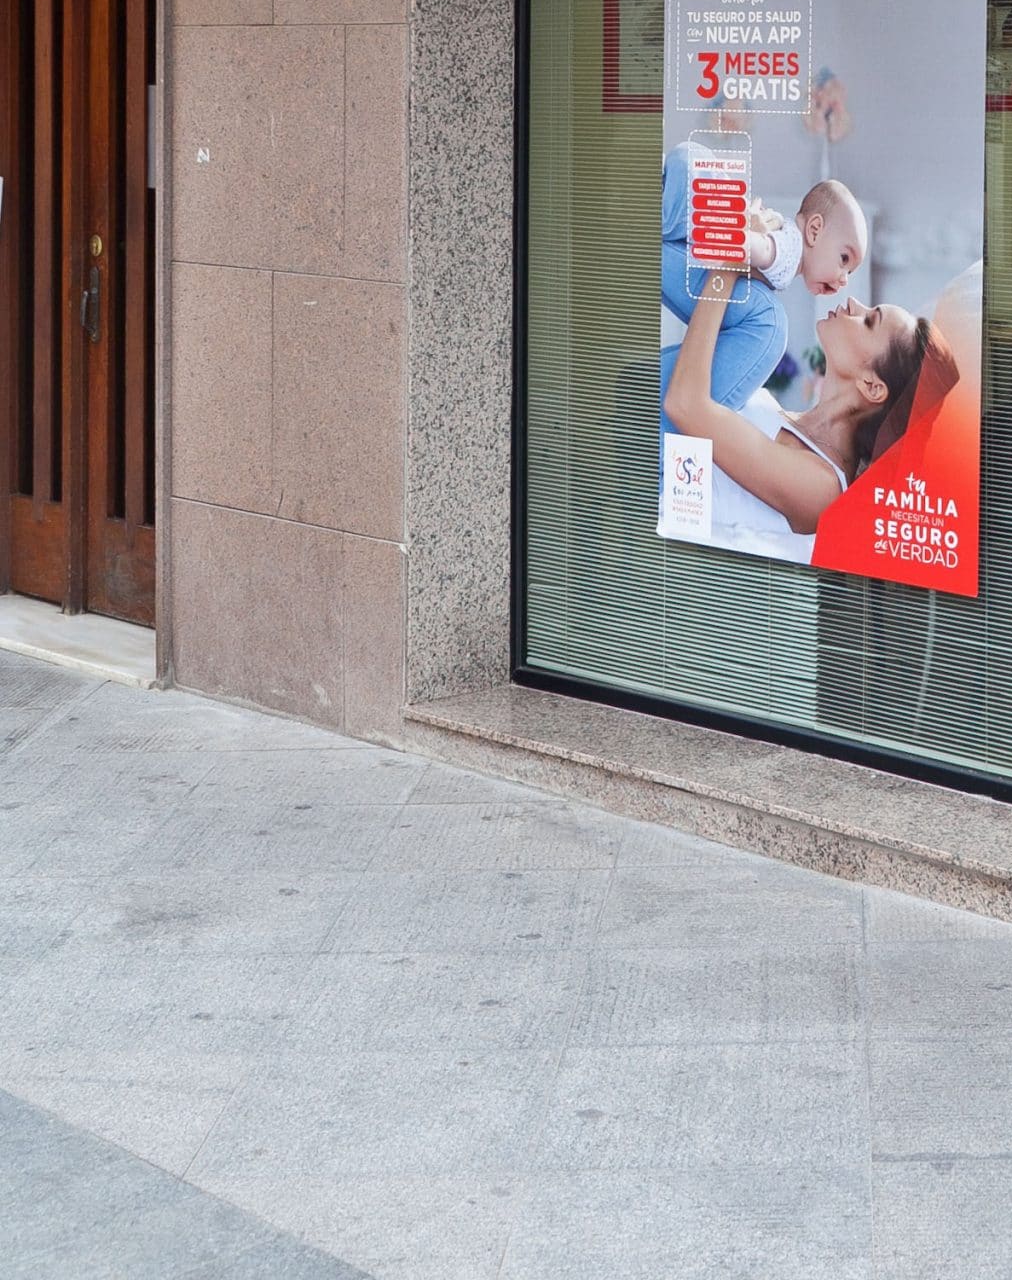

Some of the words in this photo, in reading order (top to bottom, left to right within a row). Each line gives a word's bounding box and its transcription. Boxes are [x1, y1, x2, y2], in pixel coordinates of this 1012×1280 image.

[687, 11, 700, 23] TU
[703, 11, 746, 23] SEGURO
[748, 11, 762, 23] DE
[765, 11, 801, 23] SALUD
[706, 26, 763, 44] NUEVA
[767, 26, 801, 44] APP
[687, 53, 694, 64] Y
[696, 52, 719, 99] 3
[725, 52, 800, 76] MESES
[723, 77, 801, 101] GRATIS
[695, 161, 725, 170] MAPFRE
[905, 472, 926, 496] tu
[874, 487, 958, 518] FAMILIA
[891, 510, 930, 526] NECESITA
[931, 518, 945, 527] UN
[874, 518, 959, 549] SEGURO
[888, 540, 958, 569] VERDAD
